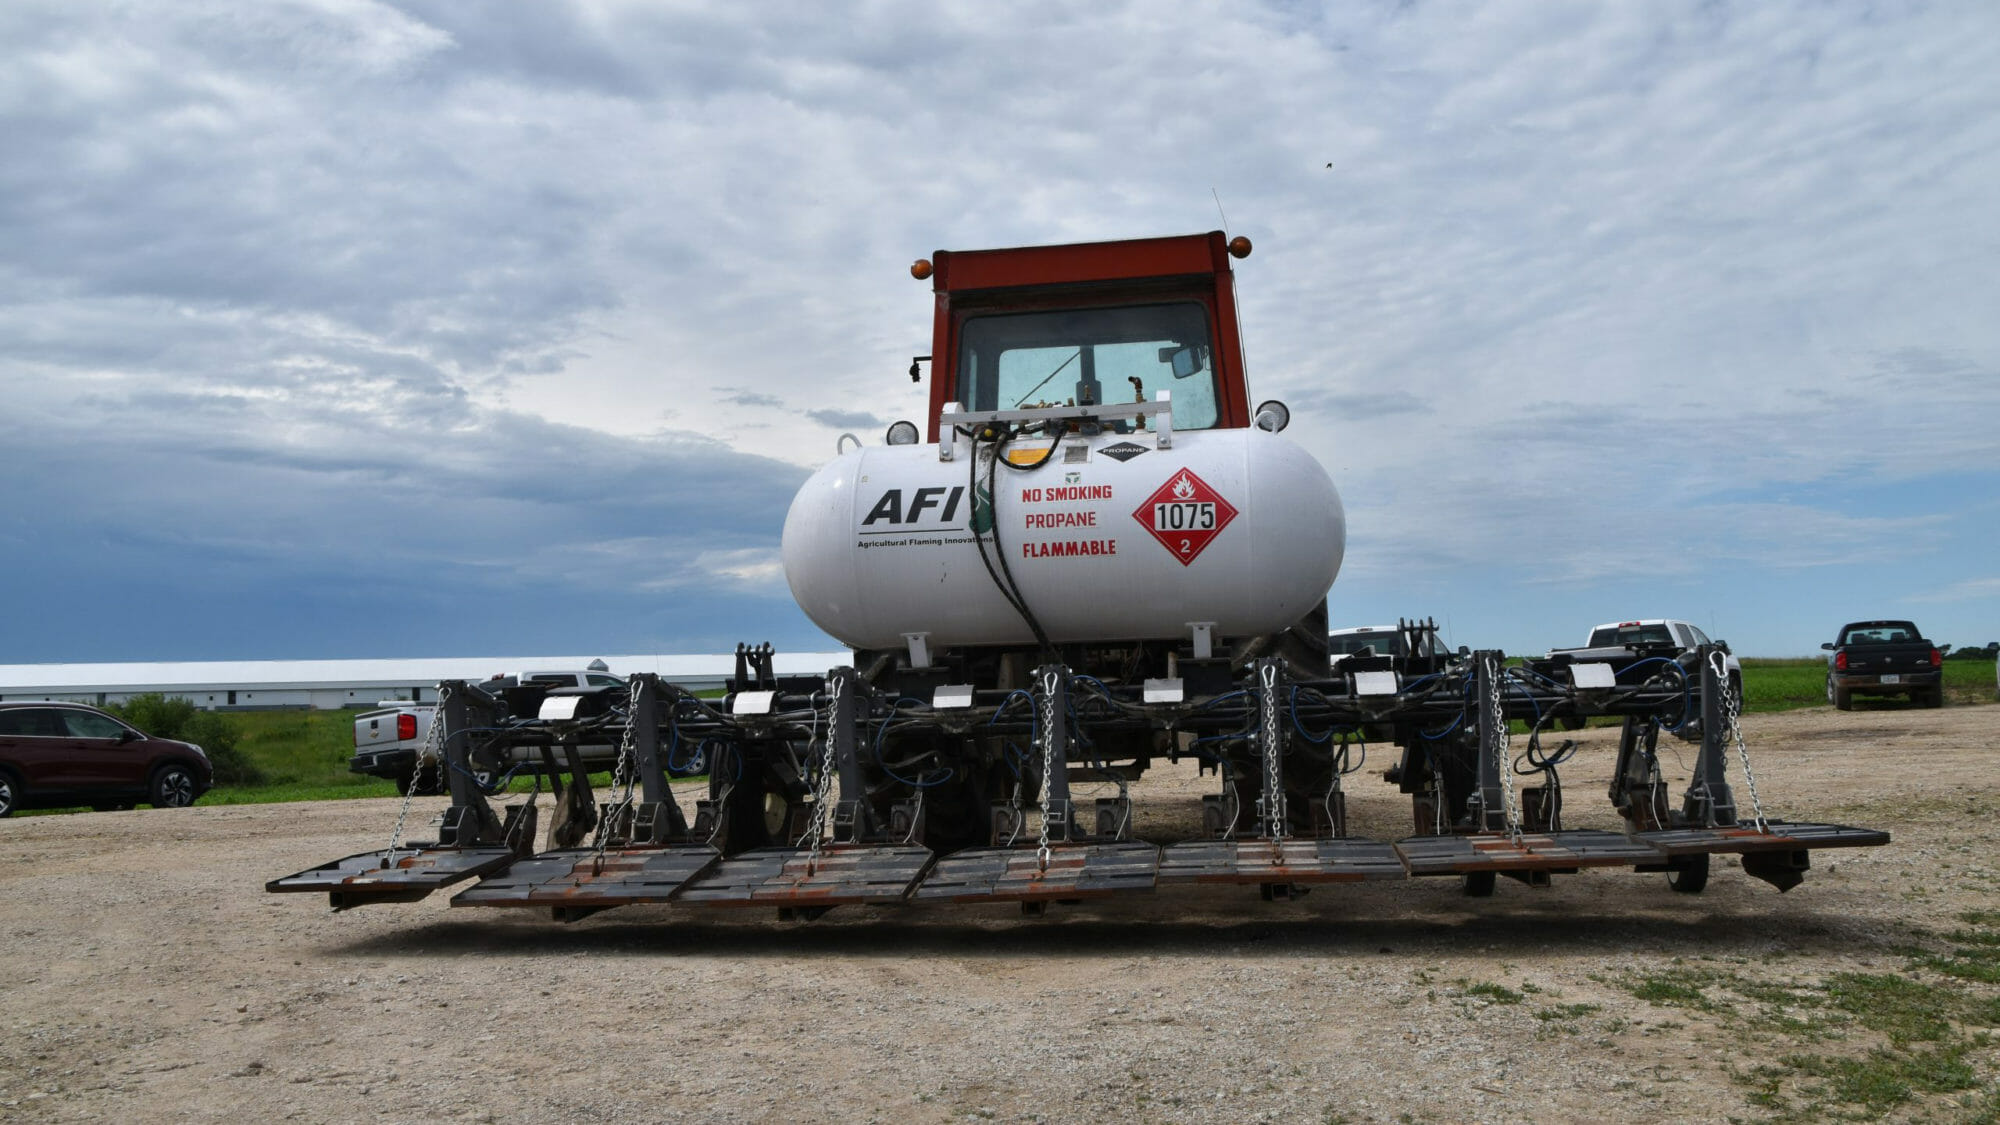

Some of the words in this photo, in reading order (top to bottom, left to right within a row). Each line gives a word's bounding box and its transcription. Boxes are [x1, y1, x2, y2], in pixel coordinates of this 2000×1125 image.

[1022, 489, 1042, 503] NO
[1046, 485, 1112, 501] SMOKING
[861, 486, 965, 525] AFI
[1026, 511, 1096, 529] PROPANE
[1158, 503, 1214, 530] 1075
[858, 539, 907, 549] Agricultural
[909, 537, 943, 546] Flaming
[944, 536, 994, 544] Innovatns
[1023, 540, 1116, 558] FLAMMABLE
[1181, 539, 1191, 553] 2
